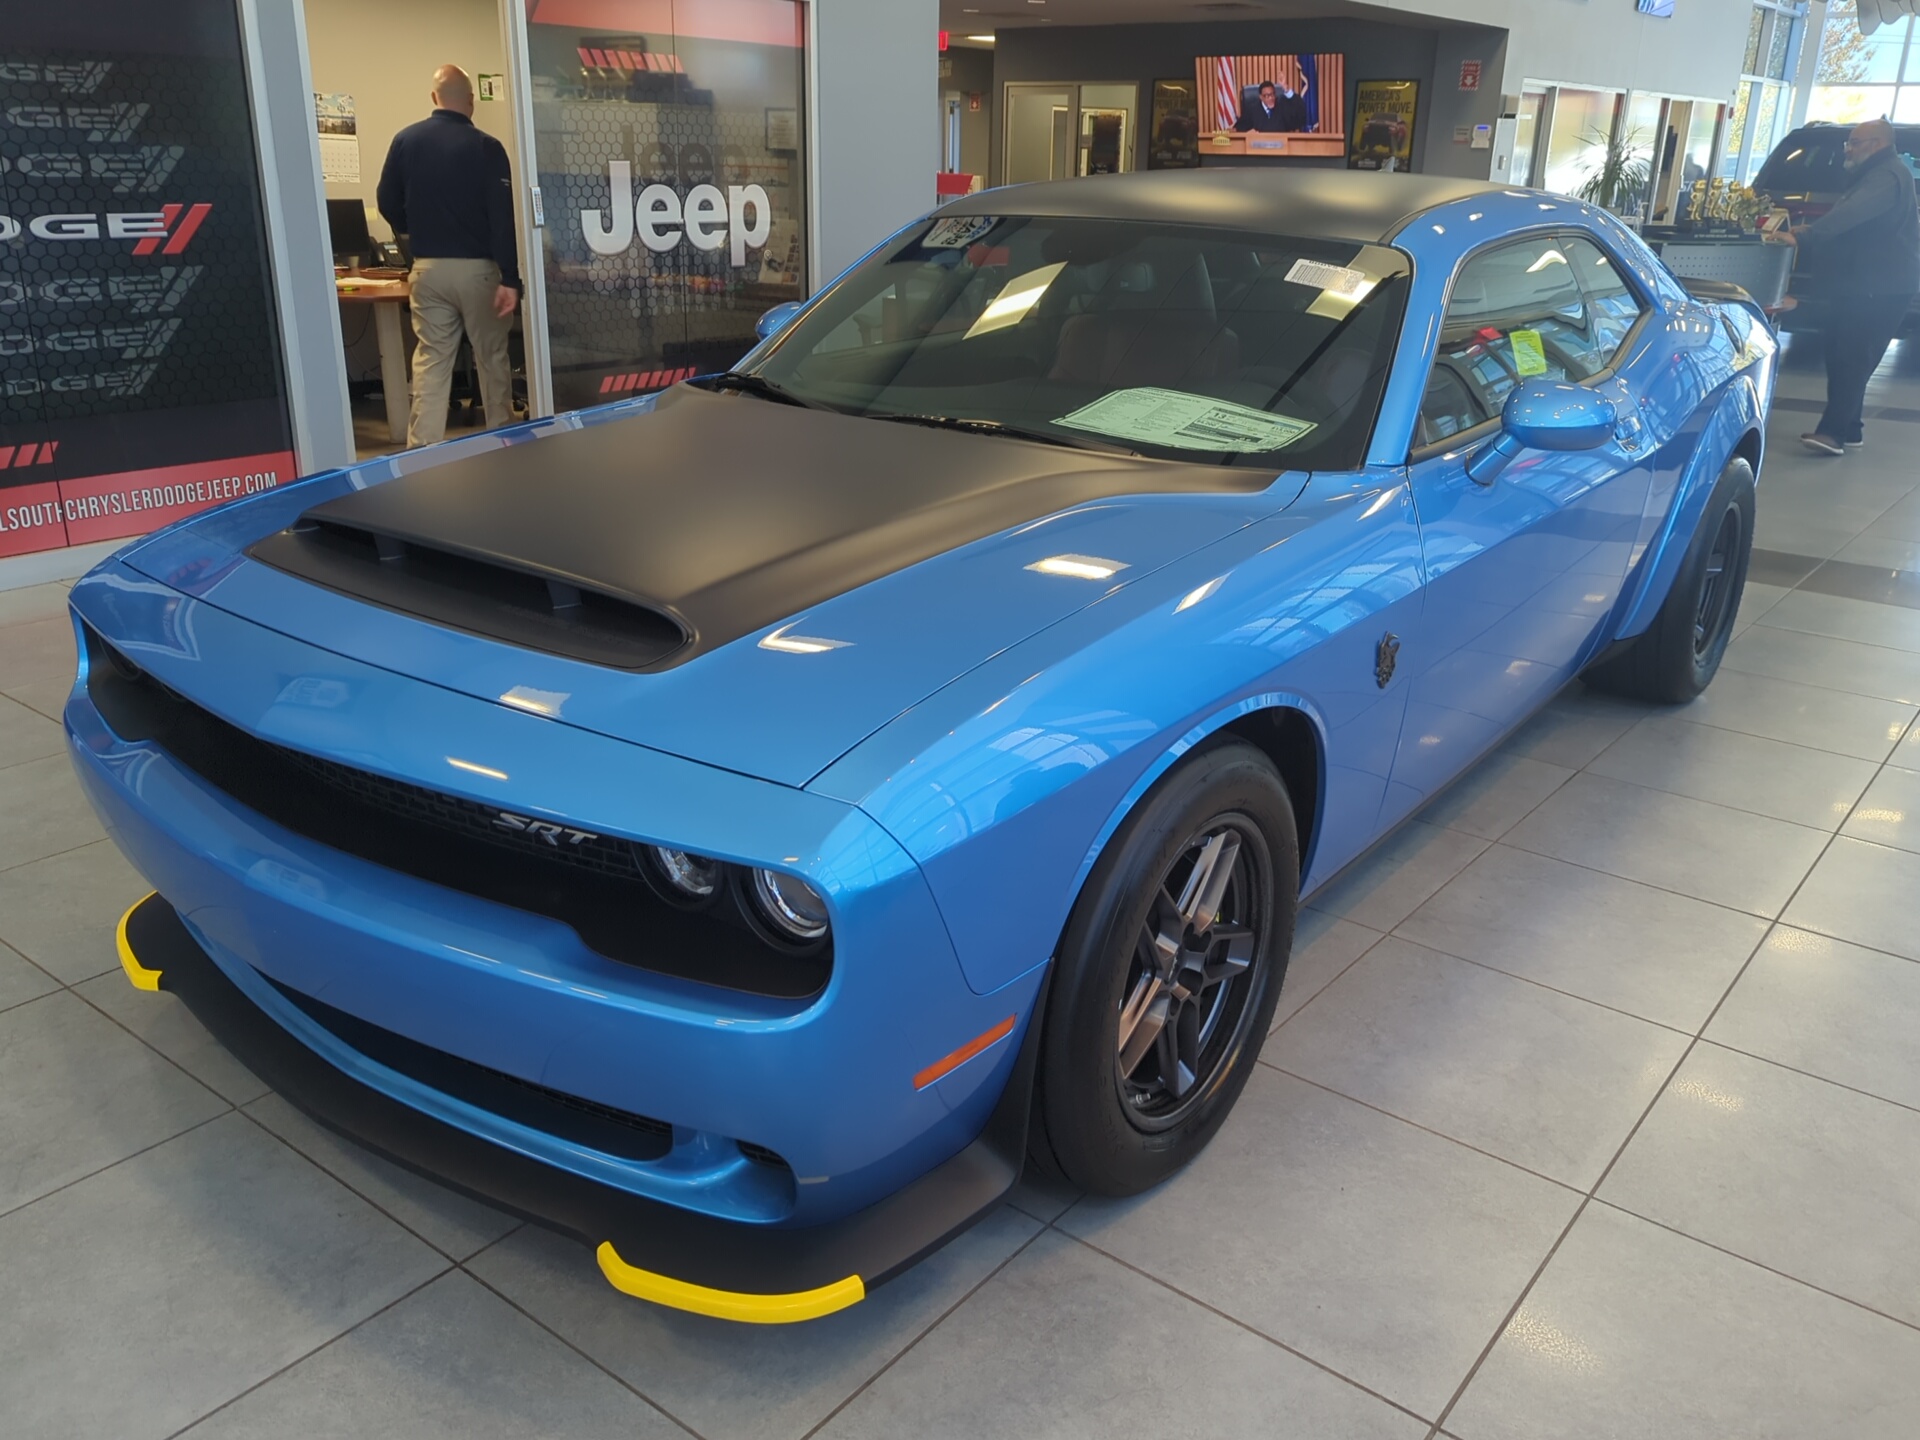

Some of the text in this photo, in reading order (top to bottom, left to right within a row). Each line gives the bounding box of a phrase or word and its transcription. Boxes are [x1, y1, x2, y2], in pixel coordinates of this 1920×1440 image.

[1360, 89, 1402, 101] AMERICA'S
[1358, 103, 1385, 114] POWER
[580, 160, 771, 267] Jeep
[493, 812, 598, 847] SRT
